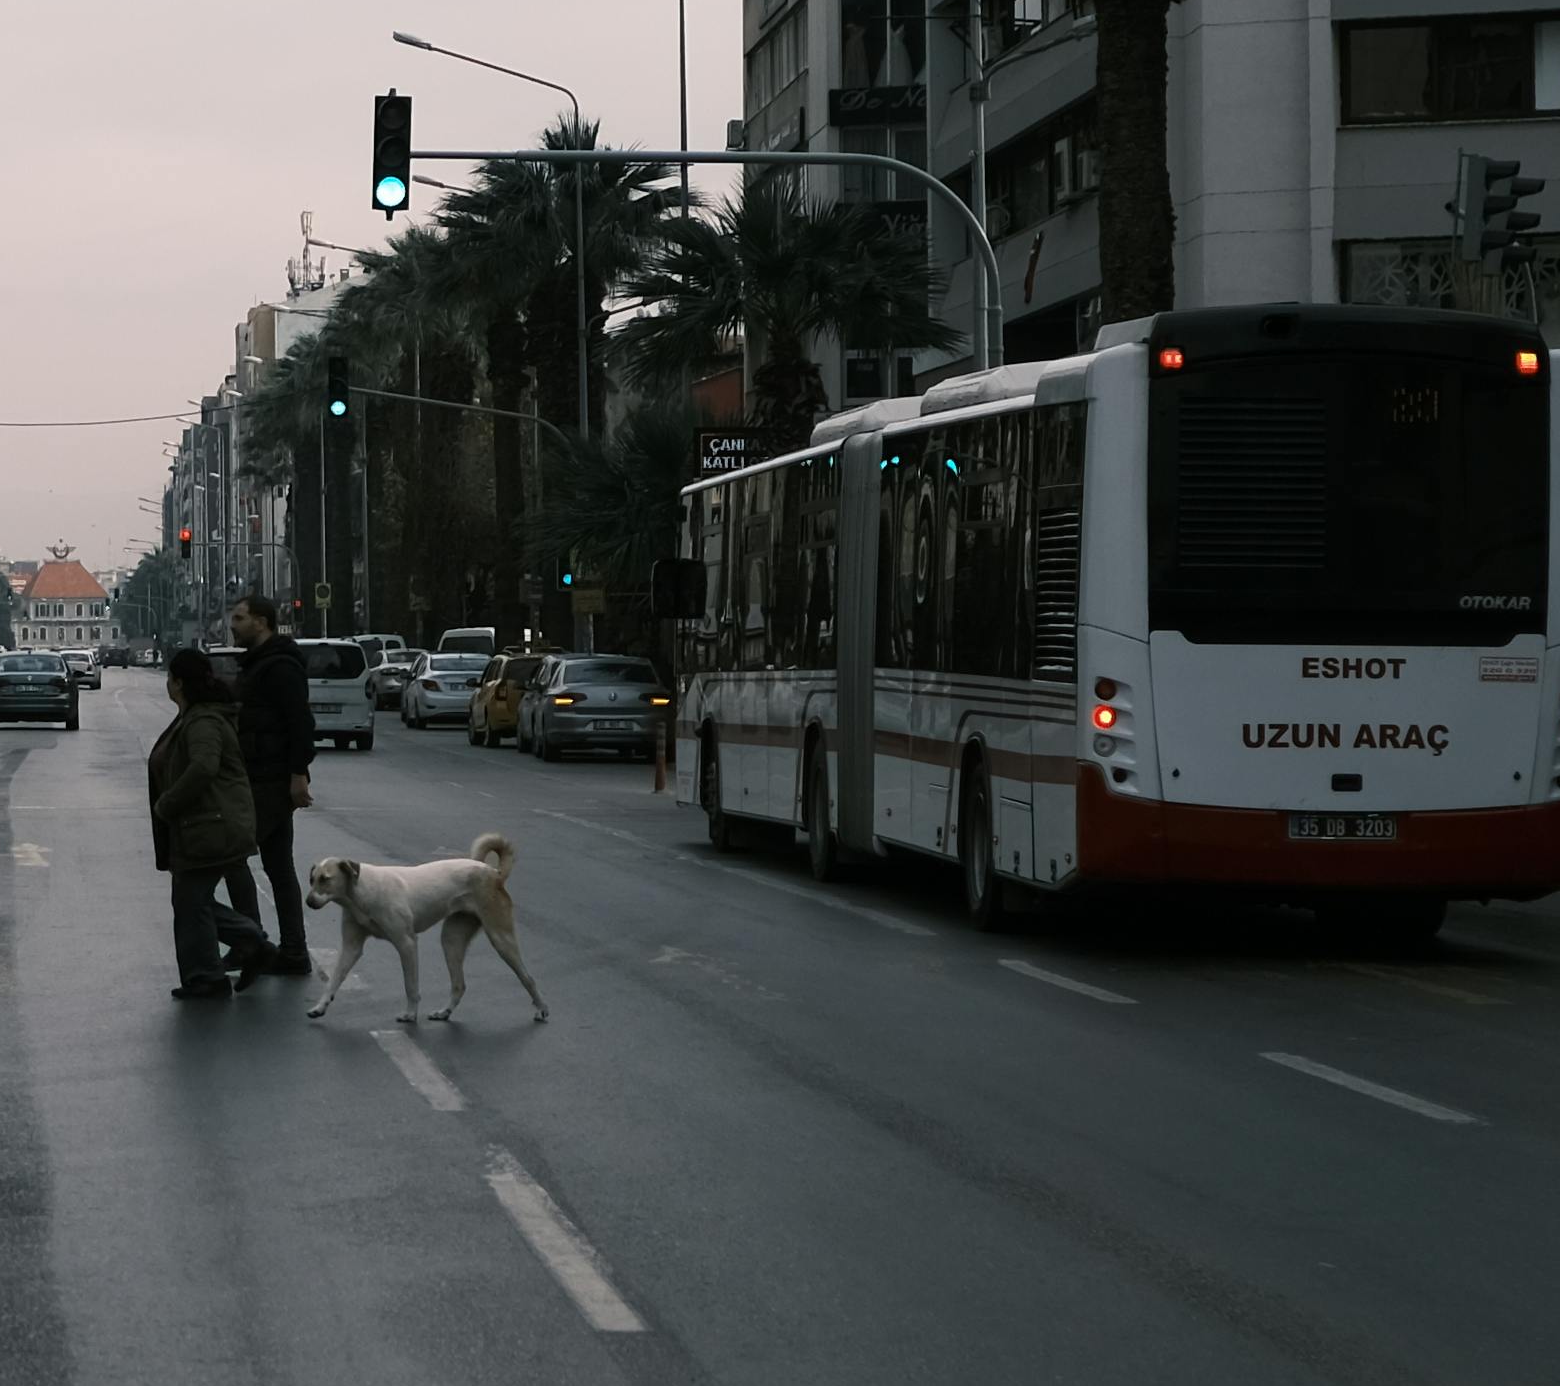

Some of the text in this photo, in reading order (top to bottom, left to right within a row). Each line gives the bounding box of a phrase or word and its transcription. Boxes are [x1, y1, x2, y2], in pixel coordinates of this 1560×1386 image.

[1457, 595, 1533, 611] OTOKAR
[1301, 657, 1408, 680] ESHOT
[1241, 723, 1451, 756] UZUN ARAÇ
[1299, 818, 1320, 836] 35
[1355, 819, 1393, 837] 3203
